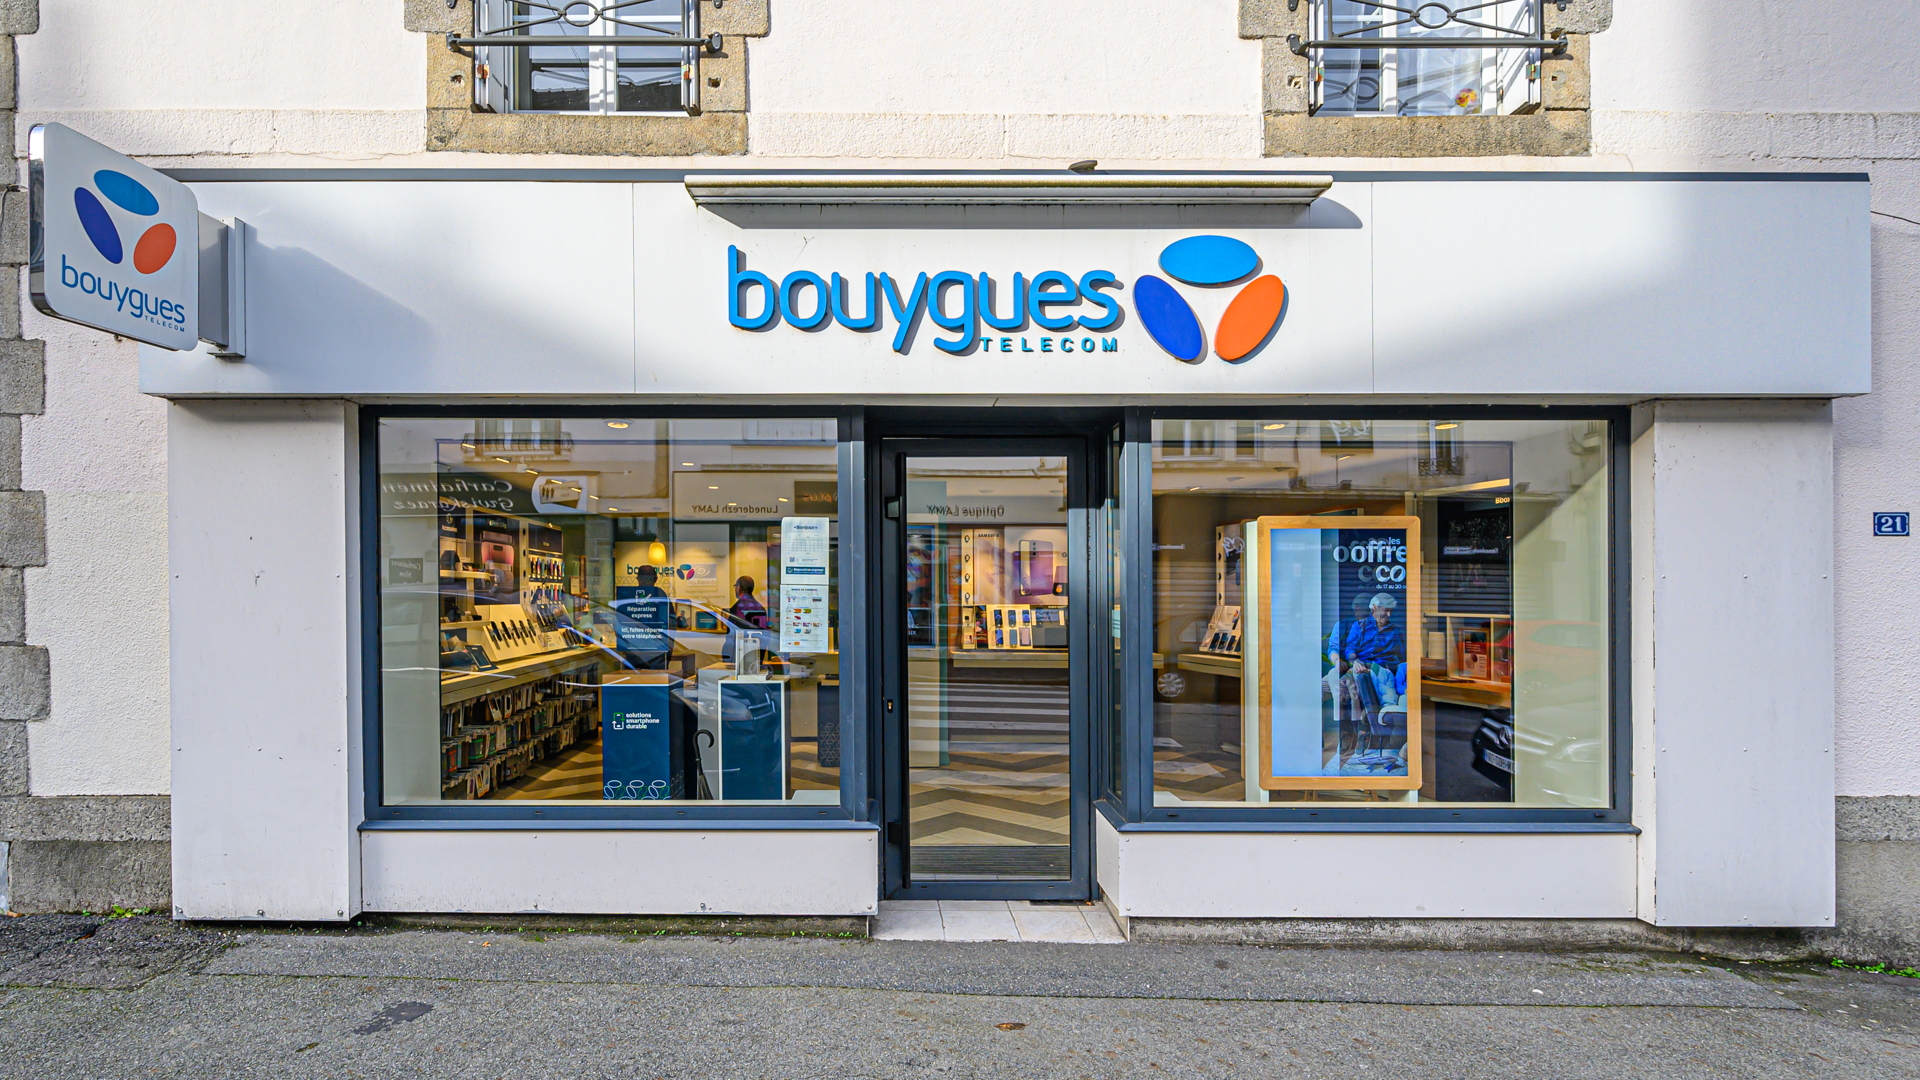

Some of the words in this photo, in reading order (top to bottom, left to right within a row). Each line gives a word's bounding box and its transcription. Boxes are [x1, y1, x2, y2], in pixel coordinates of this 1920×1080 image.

[61, 254, 186, 324] bouygues
[727, 244, 1120, 353] bouygues
[144, 315, 186, 333] TELECOM
[980, 336, 1119, 353] TELECOM
[1881, 516, 1903, 532] 21
[1388, 537, 1401, 545] les
